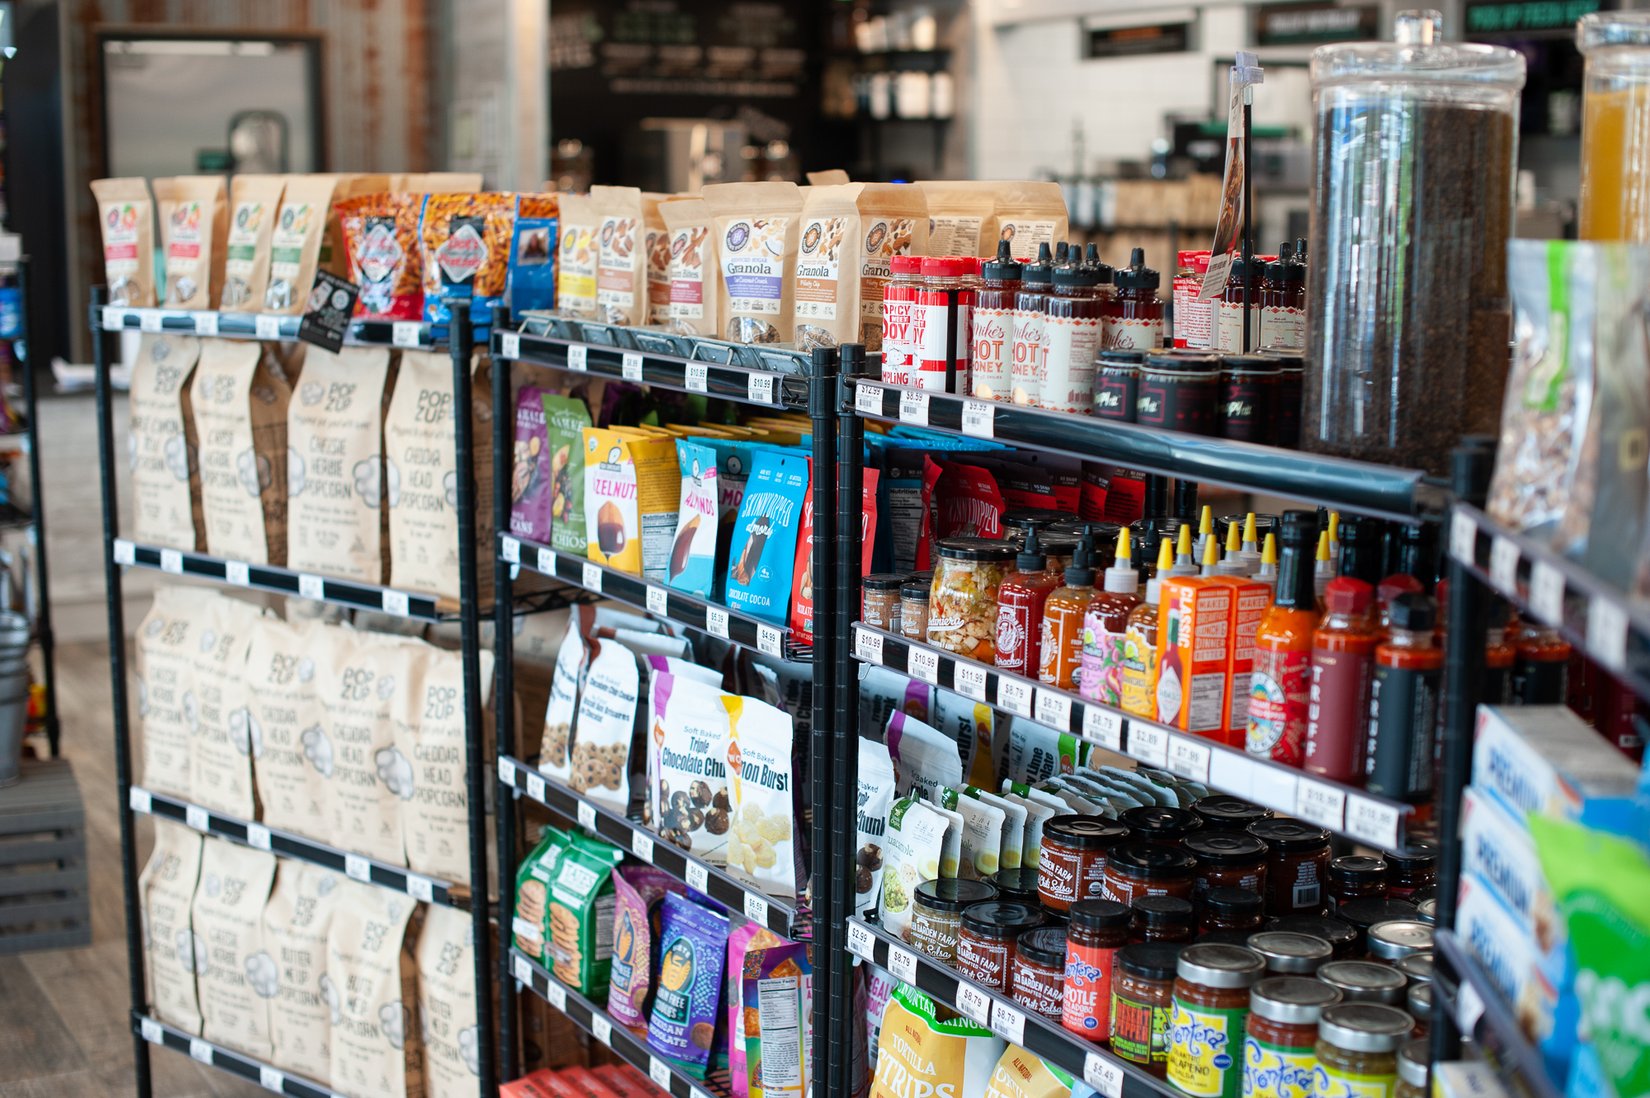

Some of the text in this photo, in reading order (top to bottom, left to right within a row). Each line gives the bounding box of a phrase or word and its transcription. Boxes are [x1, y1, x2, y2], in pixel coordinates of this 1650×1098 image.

[727, 262, 772, 275] Granola
[796, 264, 829, 277] Granola
[328, 382, 356, 398] POP
[753, 378, 771, 389] $10.99
[325, 397, 352, 412] ZUP
[419, 390, 451, 408] POP
[415, 407, 444, 424] ZUP
[750, 594, 771, 607] COCOA
[1177, 586, 1193, 648] CLASSIC
[761, 629, 776, 643] $4.99
[861, 635, 881, 648] $10.99
[914, 652, 935, 668] $10.99
[961, 669, 983, 683] $11.99
[429, 687, 456, 703] POP
[425, 703, 454, 720] ZUP
[1306, 665, 1324, 757] TRUFF
[684, 726, 721, 740] Soft Baked
[1366, 679, 1381, 775] TRUFF
[689, 737, 710, 755] Triple
[662, 747, 703, 774] Chocolate
[742, 748, 775, 765] Soft Baked
[424, 768, 451, 786] HEAD
[760, 764, 789, 792] Burst
[1054, 865, 1074, 881] FARM
[1051, 880, 1074, 895] Salsa
[851, 928, 867, 942] $2.99
[938, 933, 958, 948] FARM
[893, 951, 911, 966] $8.79
[927, 944, 951, 960] Salsa
[980, 957, 1000, 974] FARM
[976, 972, 1001, 987] Salsa
[1022, 977, 1043, 992] GARDEN
[963, 989, 982, 1007] $8.79
[1039, 1000, 1063, 1016] Salsa
[996, 1009, 1016, 1025] $8.79
[892, 1032, 936, 1076] TORTILLA
[1012, 1057, 1021, 1069] ALL
[874, 1047, 956, 1098] STRIPS
[1093, 1062, 1114, 1082] $5.49
